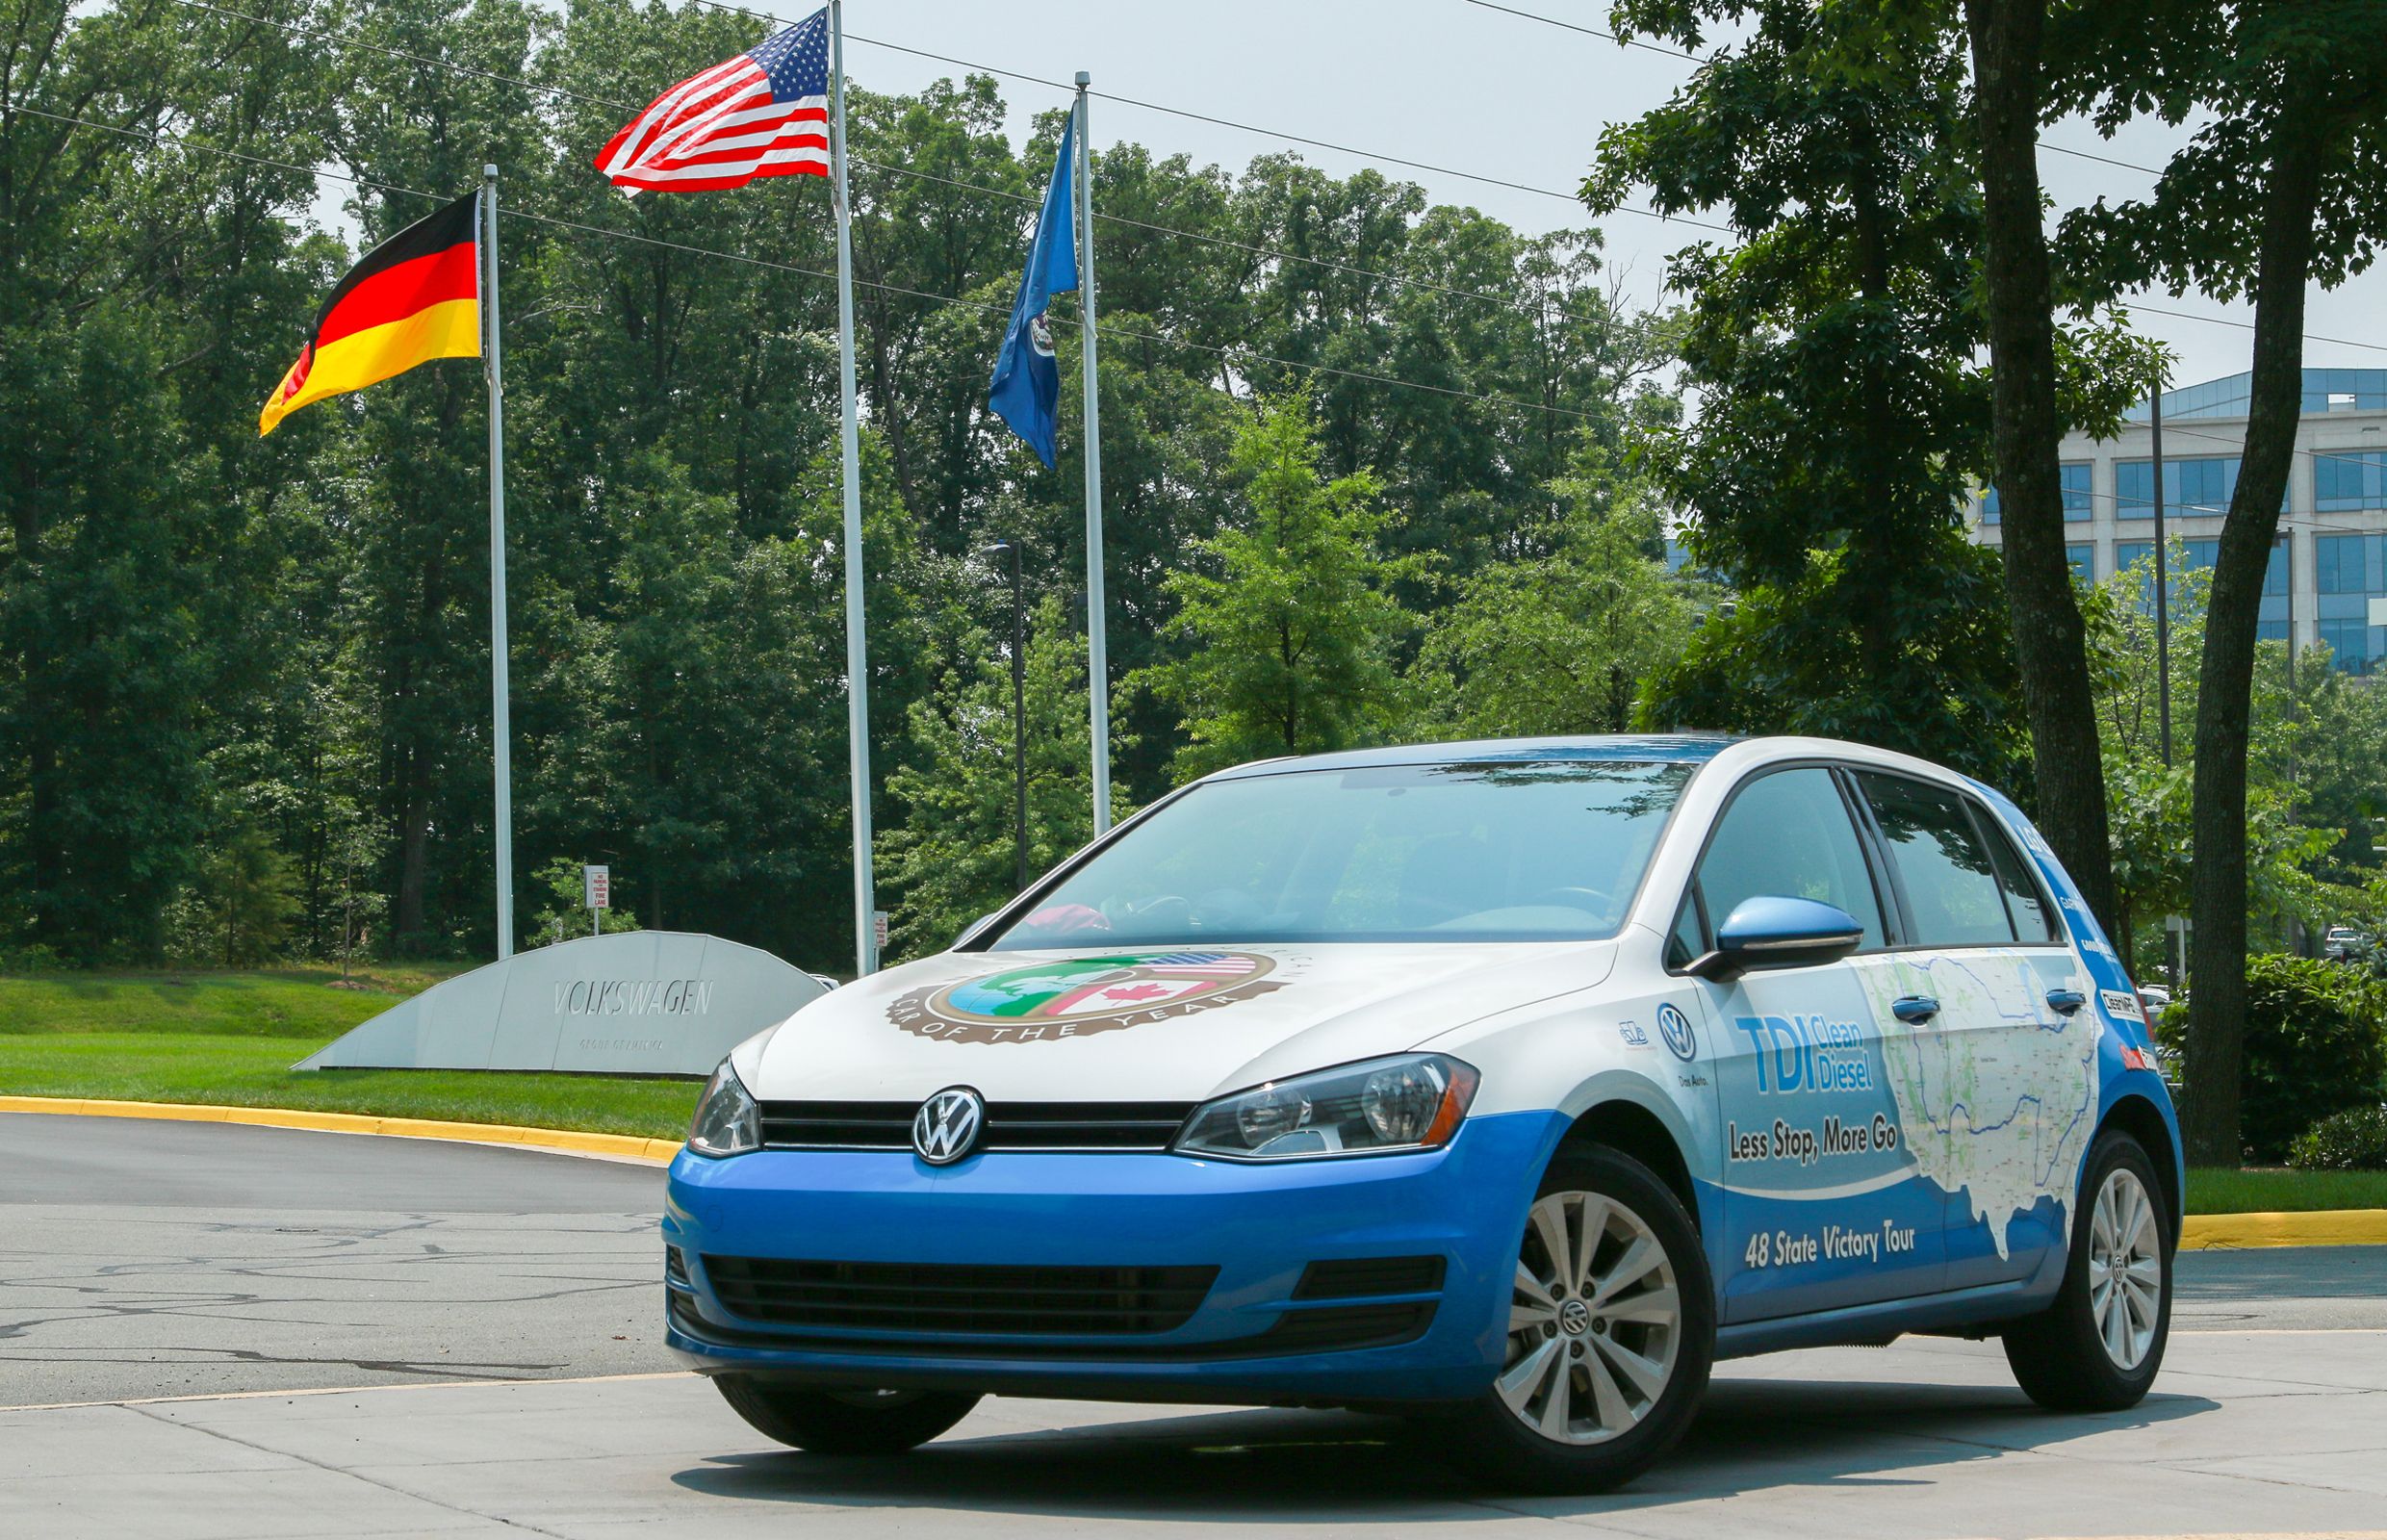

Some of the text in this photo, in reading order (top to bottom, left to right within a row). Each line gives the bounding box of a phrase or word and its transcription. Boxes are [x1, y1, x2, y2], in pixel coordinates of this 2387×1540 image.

[554, 980, 714, 1015] VOLKSWAGEN
[894, 995, 1238, 1040] CAR OF THE YEAR
[1810, 1015, 1863, 1048] Clean
[1735, 1016, 1815, 1092] TDI
[1818, 1053, 1872, 1090] Diesel
[1679, 1075, 1691, 1088] Das
[1730, 1115, 1897, 1165] Less Stop, More Go
[1745, 1219, 1915, 1269] 48 State Victory Tour
